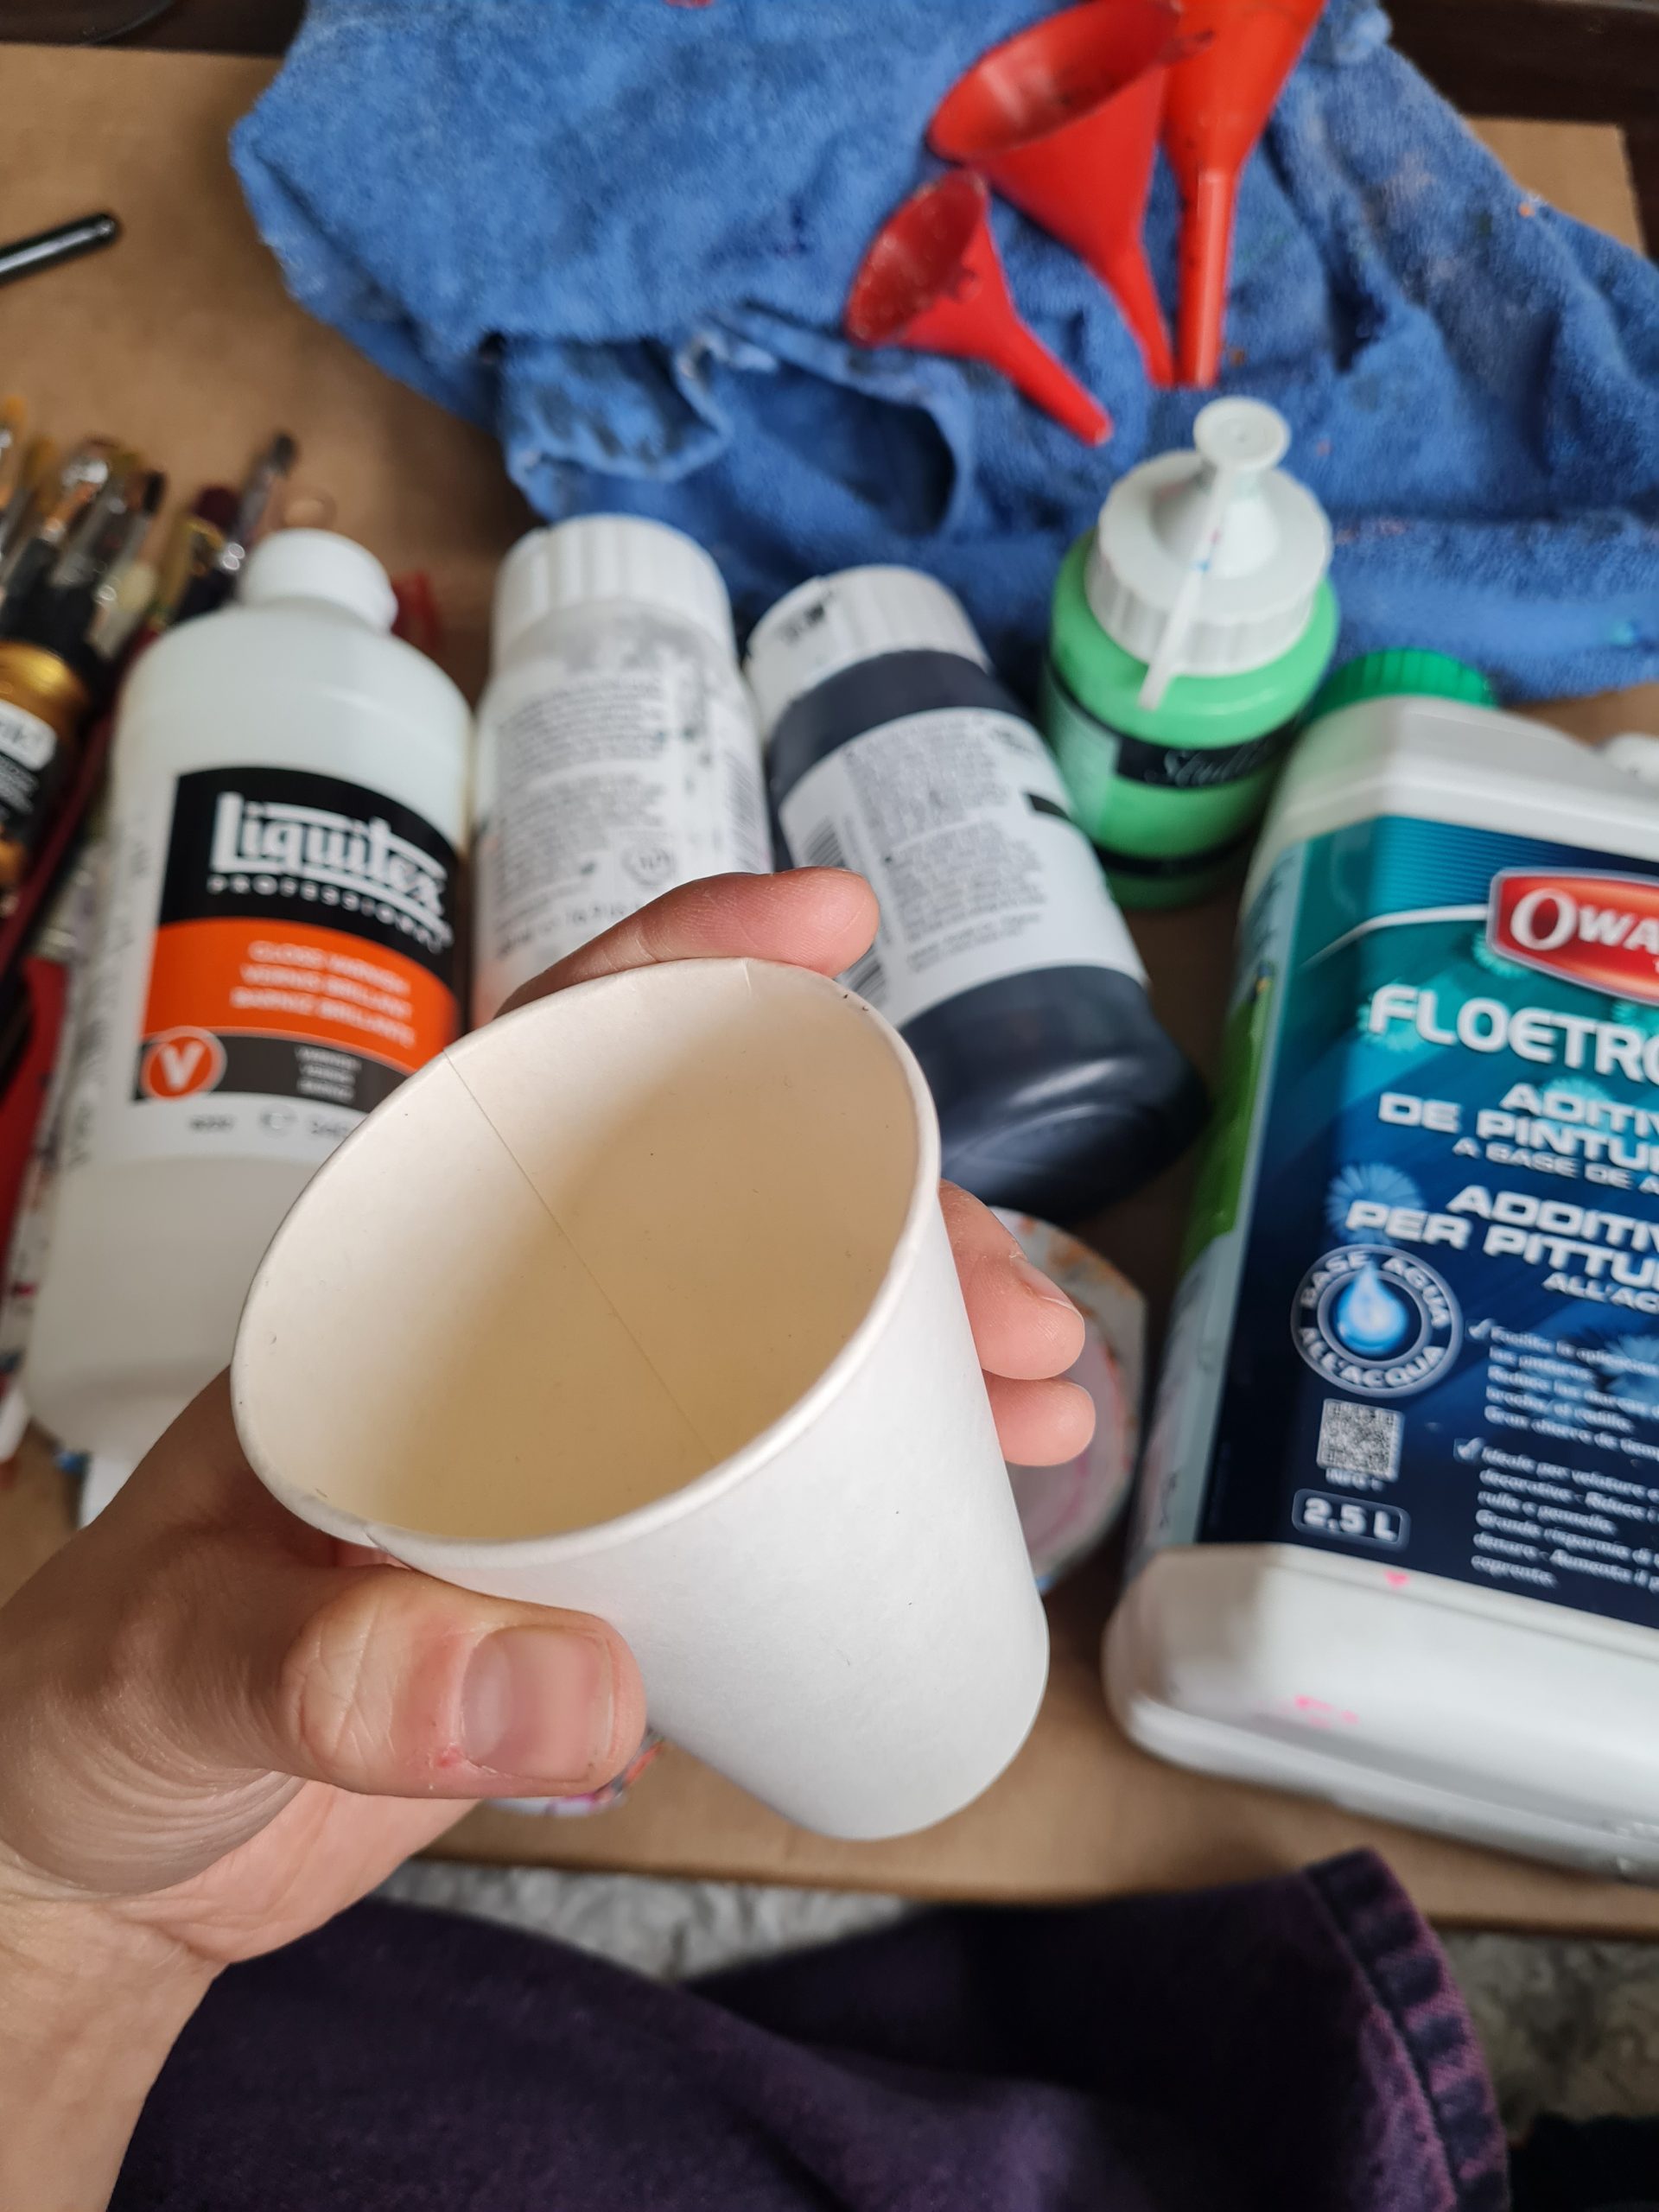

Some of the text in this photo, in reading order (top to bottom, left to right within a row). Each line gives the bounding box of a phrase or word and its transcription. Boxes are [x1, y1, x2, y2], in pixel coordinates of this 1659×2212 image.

[211, 790, 448, 921] Liquitex
[161, 1041, 206, 1090] V
[1379, 1091, 1461, 1134] DE
[1452, 1137, 1480, 1159] A
[1485, 1141, 1580, 1178] BASE
[1585, 1161, 1634, 1190] DE
[1345, 1200, 1659, 1291] PER PITTU
[1373, 1510, 1398, 1542] L
